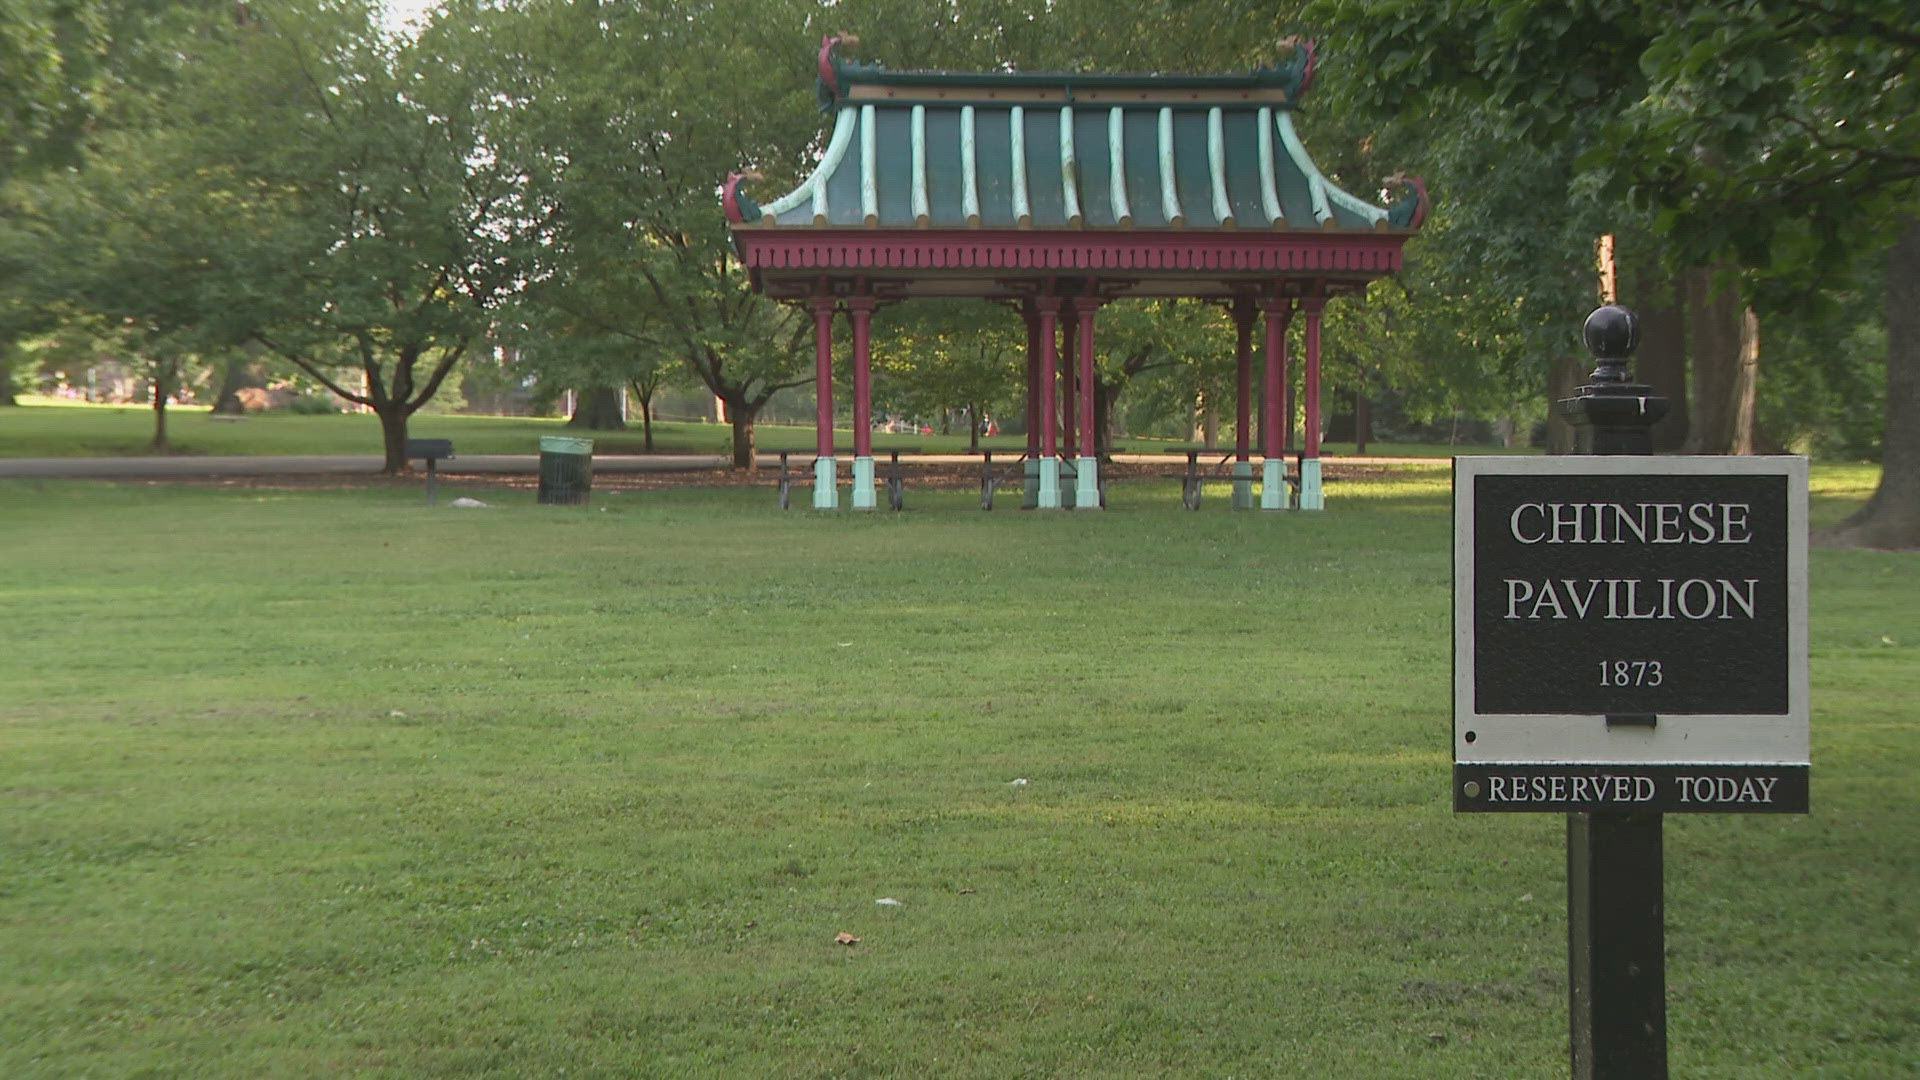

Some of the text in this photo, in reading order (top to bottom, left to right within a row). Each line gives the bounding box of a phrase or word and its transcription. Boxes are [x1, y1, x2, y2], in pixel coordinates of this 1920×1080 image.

[1510, 503, 1752, 544] CHINESE
[1503, 579, 1759, 619] PAVILION
[1600, 661, 1662, 686] 1873
[1488, 776, 1778, 802] RESERVED TODAY
